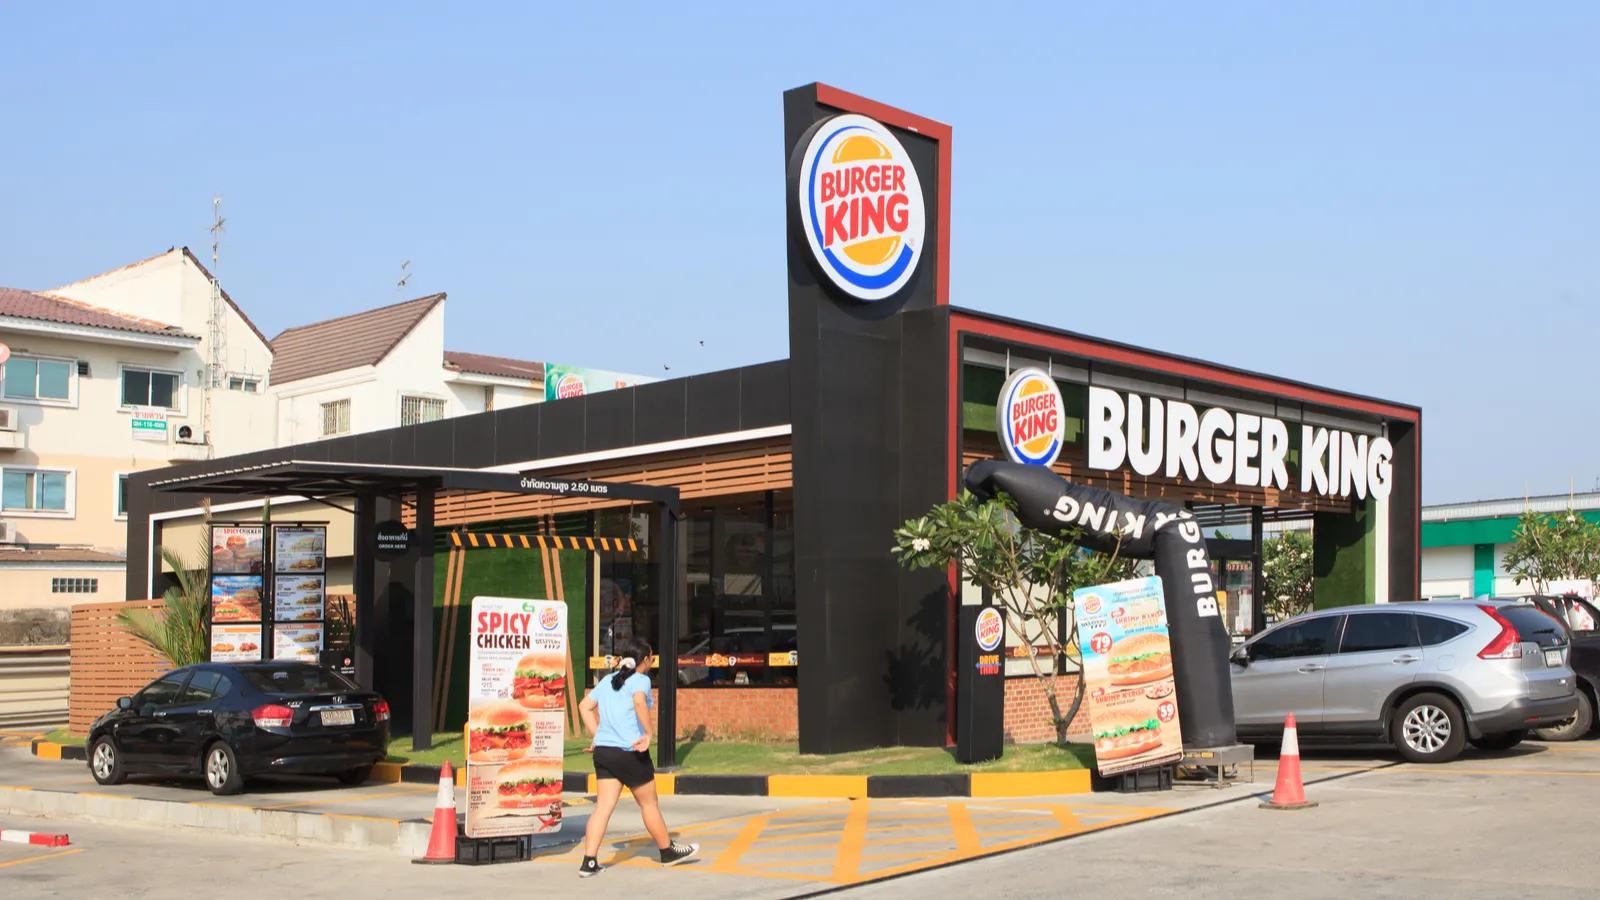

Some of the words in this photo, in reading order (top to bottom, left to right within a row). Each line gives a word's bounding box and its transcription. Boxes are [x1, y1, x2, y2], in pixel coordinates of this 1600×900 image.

[821, 165, 906, 204] BURGER
[824, 193, 909, 247] KING
[560, 381, 583, 394] BURGER
[1012, 393, 1056, 421] BURGER
[1014, 408, 1058, 446] KING
[1088, 386, 1289, 490] BURGER
[1301, 424, 1393, 500] KING
[520, 477, 569, 493] จำกัดความสูง
[571, 482, 589, 492] 2.50
[590, 484, 608, 493] เมตร
[1053, 495, 1146, 539] KING
[477, 612, 531, 634] SPICY
[542, 616, 558, 625] KING
[979, 616, 999, 630] BURGER
[1115, 615, 1140, 625] SHRIMP
[980, 623, 999, 640] KING
[477, 634, 530, 649] CHICKEN
[979, 655, 999, 664] DRIVE
[980, 665, 998, 675] THRU
[1095, 694, 1120, 704] SHRIMP
[1160, 704, 1174, 717] 59
